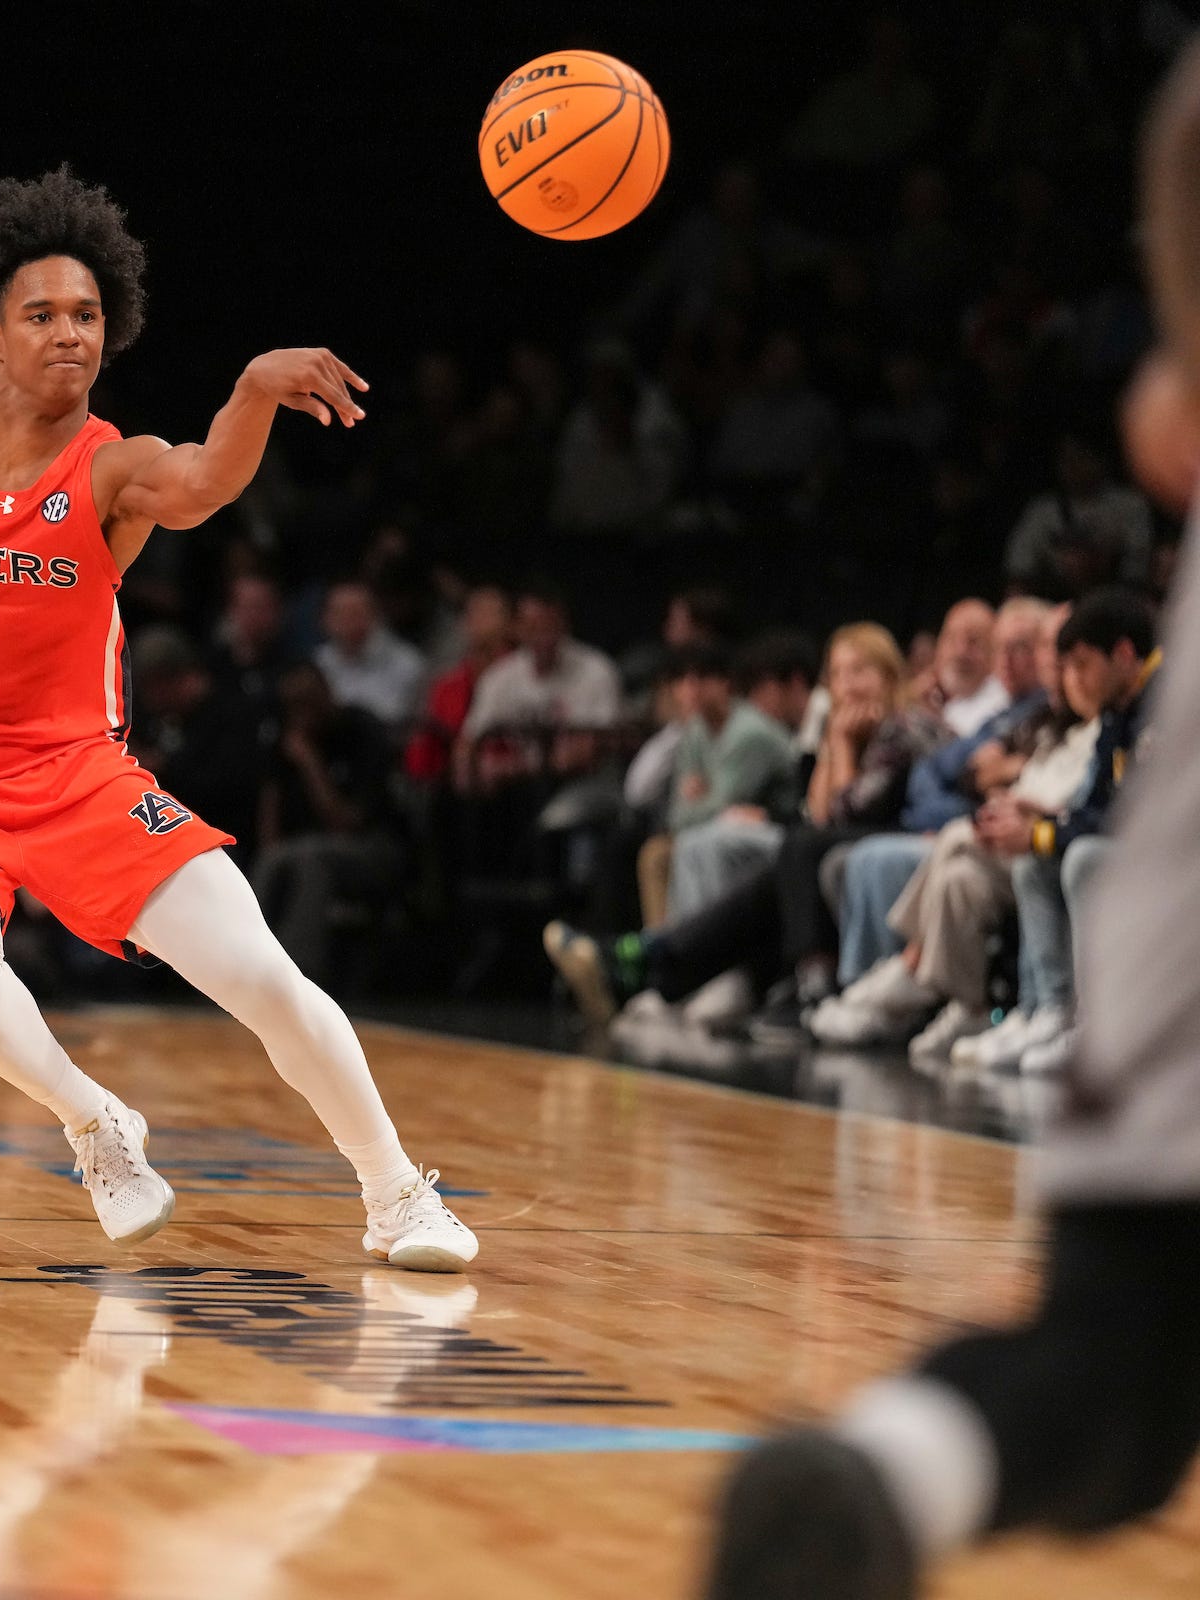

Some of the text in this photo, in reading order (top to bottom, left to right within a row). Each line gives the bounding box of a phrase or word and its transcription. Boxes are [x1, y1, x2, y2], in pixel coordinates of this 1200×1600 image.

[482, 64, 567, 118] ilson
[495, 111, 547, 168] EVO
[42, 492, 68, 522] SEC
